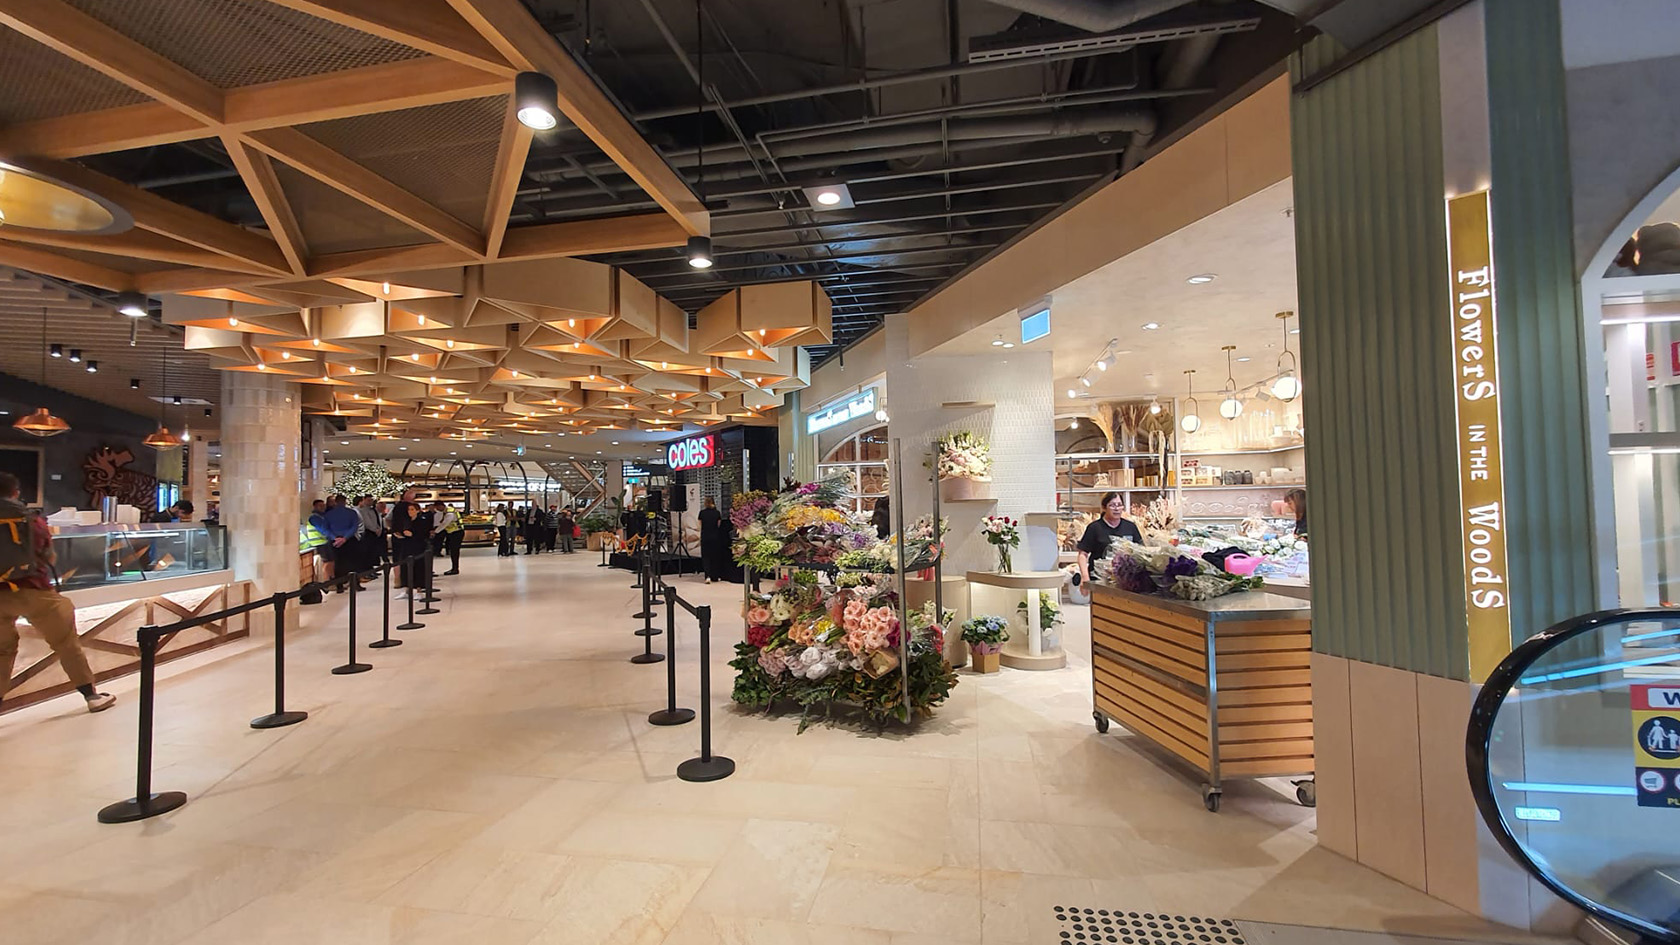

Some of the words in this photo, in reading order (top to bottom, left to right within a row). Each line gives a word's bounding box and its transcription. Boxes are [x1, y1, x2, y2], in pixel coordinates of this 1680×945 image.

[1468, 424, 1487, 443] IN
[668, 437, 708, 469] coles
[1470, 445, 1489, 482] THE
